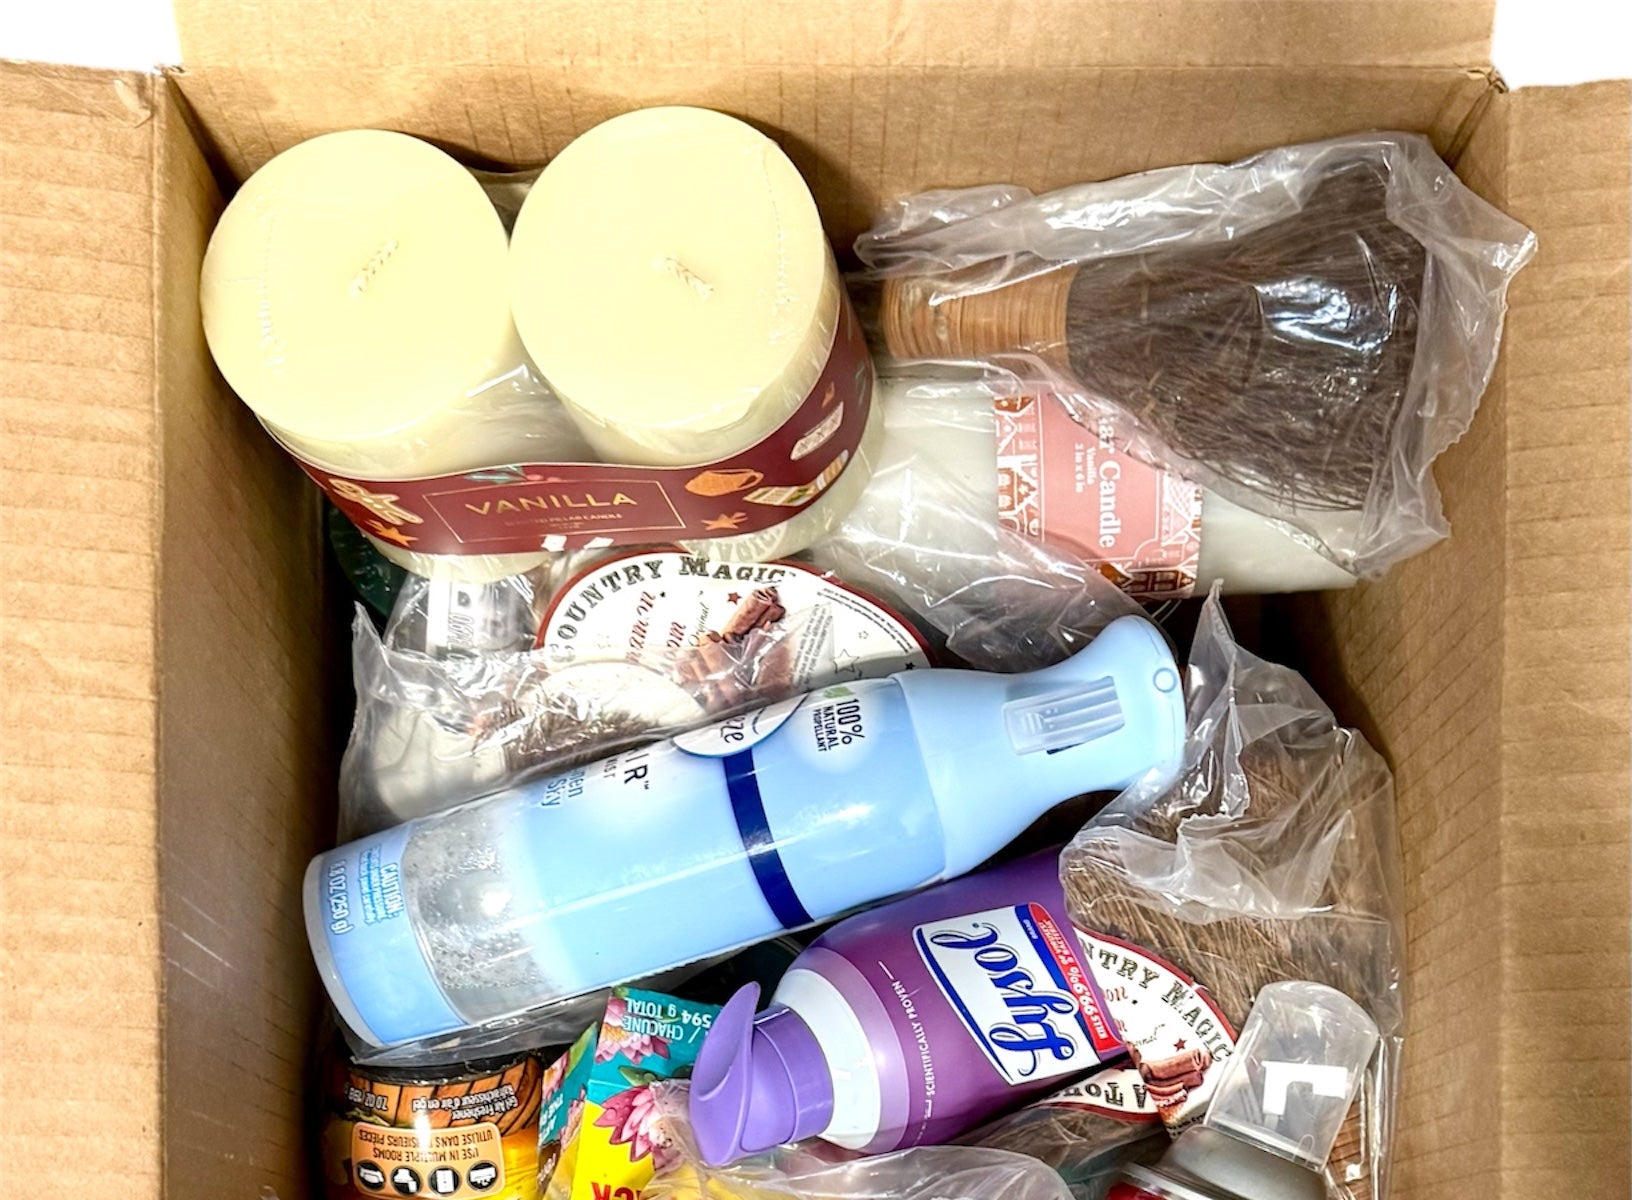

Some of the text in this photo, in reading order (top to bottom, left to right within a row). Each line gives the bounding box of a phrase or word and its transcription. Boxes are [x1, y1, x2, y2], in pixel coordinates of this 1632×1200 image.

[1087, 447, 1095, 485] Vanilla
[465, 492, 637, 515] VANILLA
[1099, 460, 1121, 548] Candle
[679, 555, 786, 583] MAGIC
[823, 705, 839, 751] NATURAL
[837, 699, 865, 744] 100%
[930, 921, 1077, 1078] Lysol
[1068, 965, 1098, 1017] 99.9%
[626, 998, 665, 1020] TOTAL
[681, 1009, 712, 1027] 594
[623, 1015, 684, 1040] CHACUNE
[892, 980, 936, 1096] SCIENTIFICALLY PROVEN
[1089, 1014, 1108, 1040] KILLS
[436, 1136, 460, 1148] DANS
[464, 1130, 492, 1144] UTILISE
[374, 1147, 403, 1161] ROOMS
[450, 1149, 459, 1161] IN
